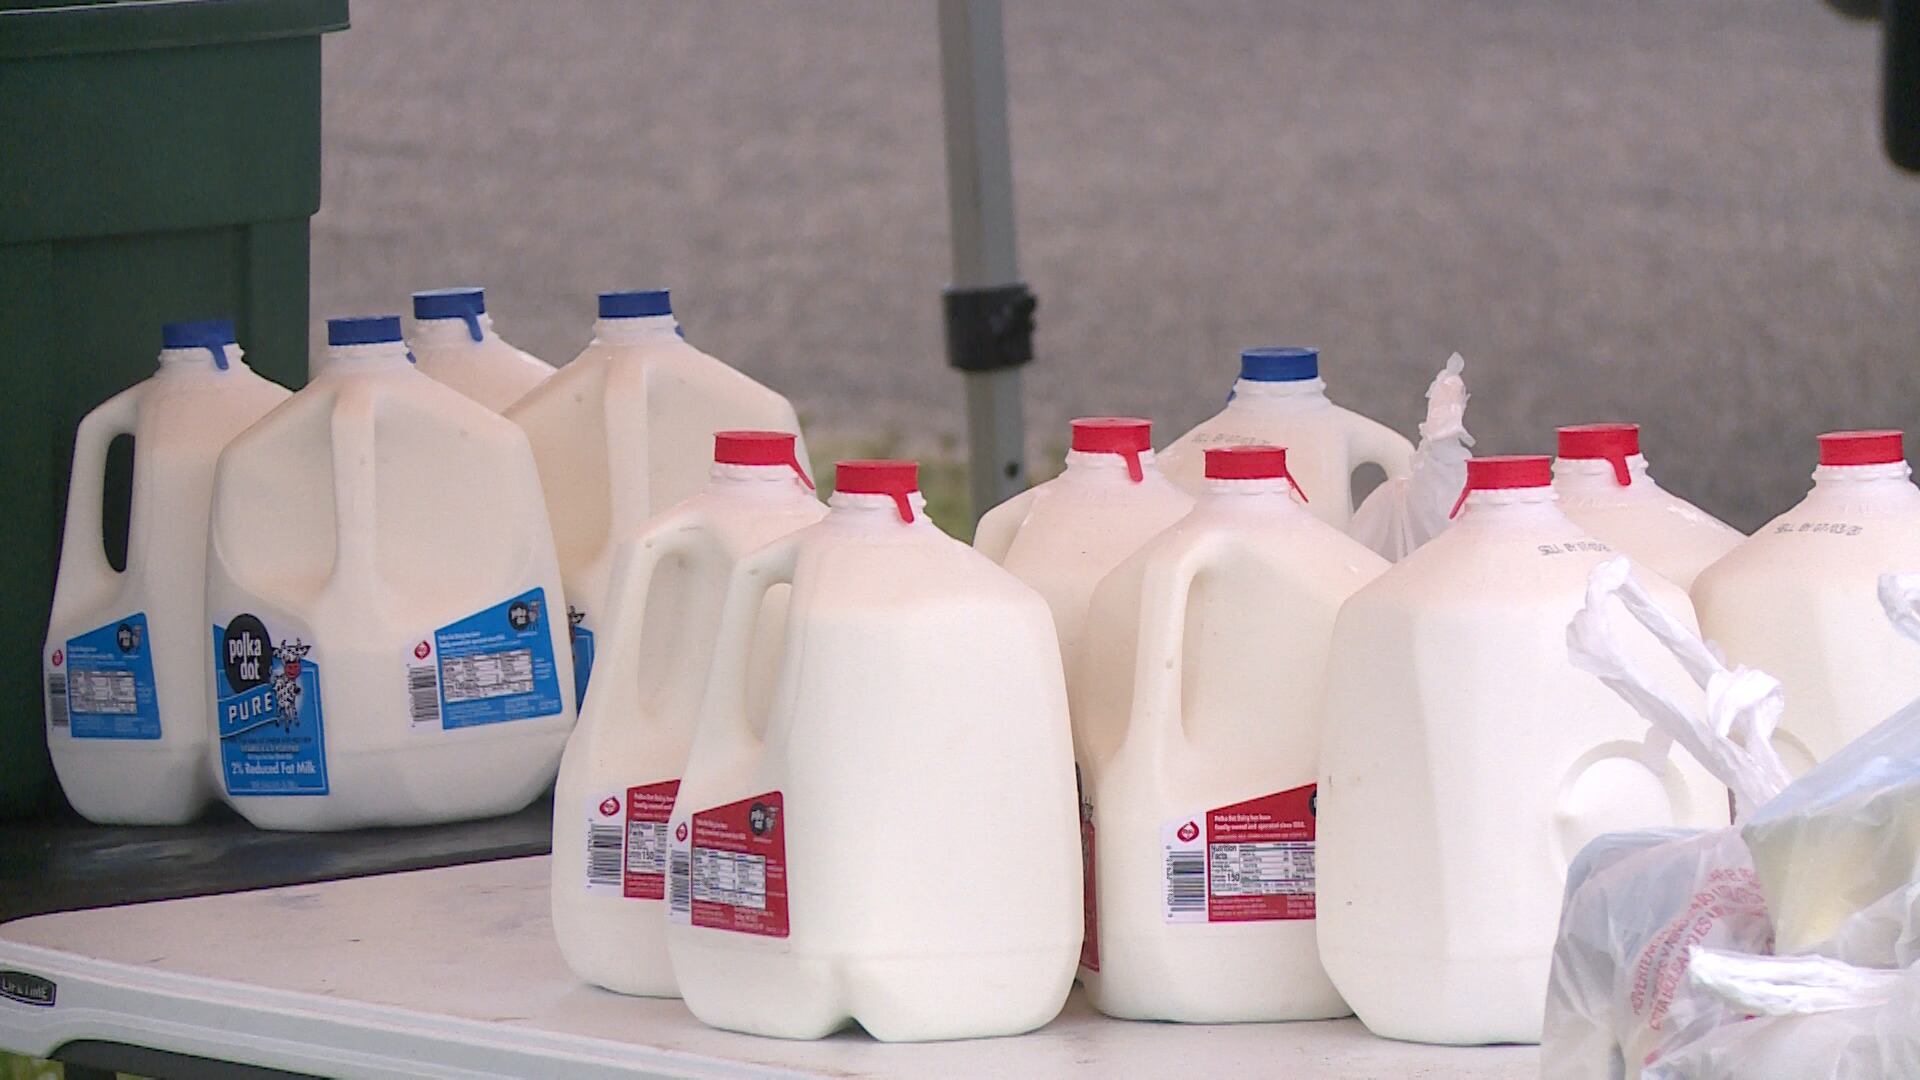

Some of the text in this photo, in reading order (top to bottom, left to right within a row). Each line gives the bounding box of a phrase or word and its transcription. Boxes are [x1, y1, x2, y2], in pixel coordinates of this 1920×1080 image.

[228, 631, 262, 664] polka
[240, 657, 260, 680] dot
[228, 691, 273, 725] PURE
[231, 760, 317, 775] 2% Reduced Fat Milk
[1227, 872, 1240, 882] 150
